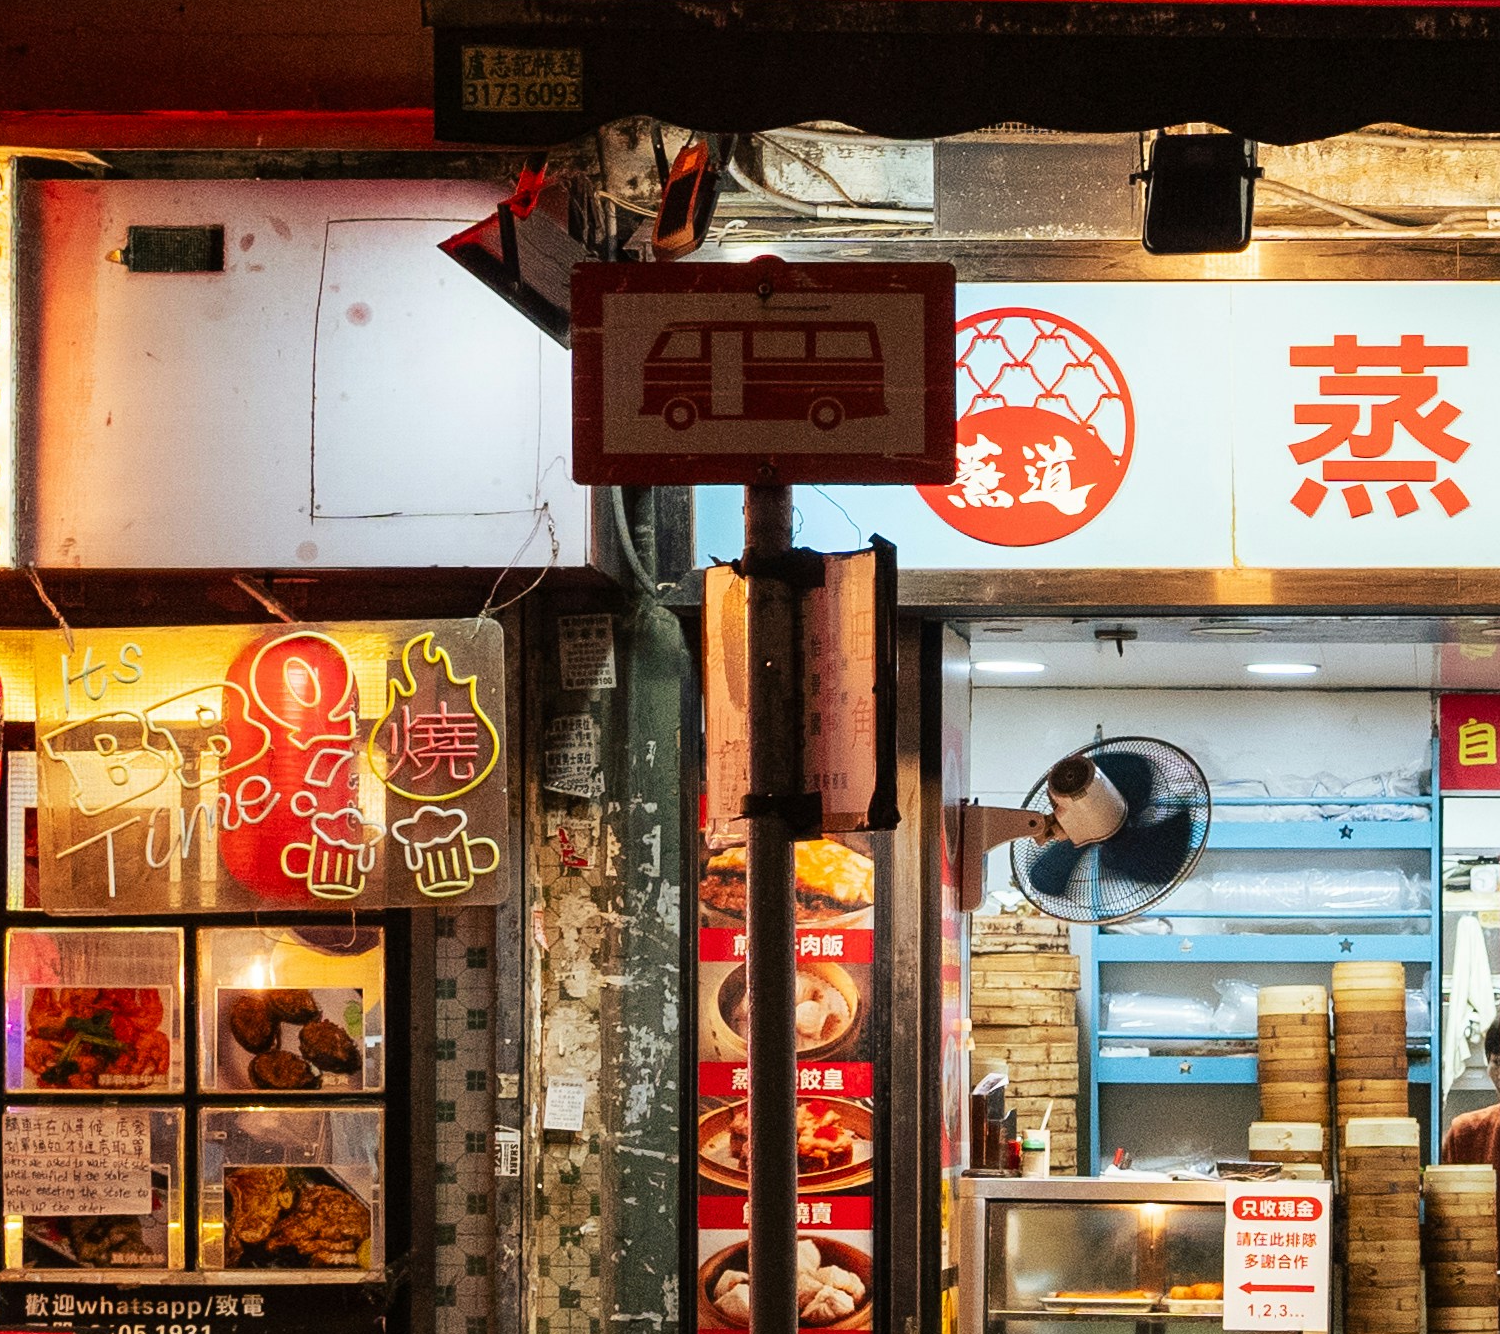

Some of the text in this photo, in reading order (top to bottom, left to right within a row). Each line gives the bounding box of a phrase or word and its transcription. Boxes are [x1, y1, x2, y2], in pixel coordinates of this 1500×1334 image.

[464, 82, 580, 107] 3173 6093
[944, 434, 1097, 516] 蒸道
[387, 700, 479, 784] 燒
[732, 933, 845, 958] 煎肉飯
[730, 1068, 845, 1092] 蒸餃皇
[1241, 1199, 1314, 1218] 只收現金
[1237, 1231, 1317, 1248] 請在此排隊
[1245, 1253, 1309, 1270] 多謝合作
[25, 1293, 265, 1319] 歡迎whatsapp/致電
